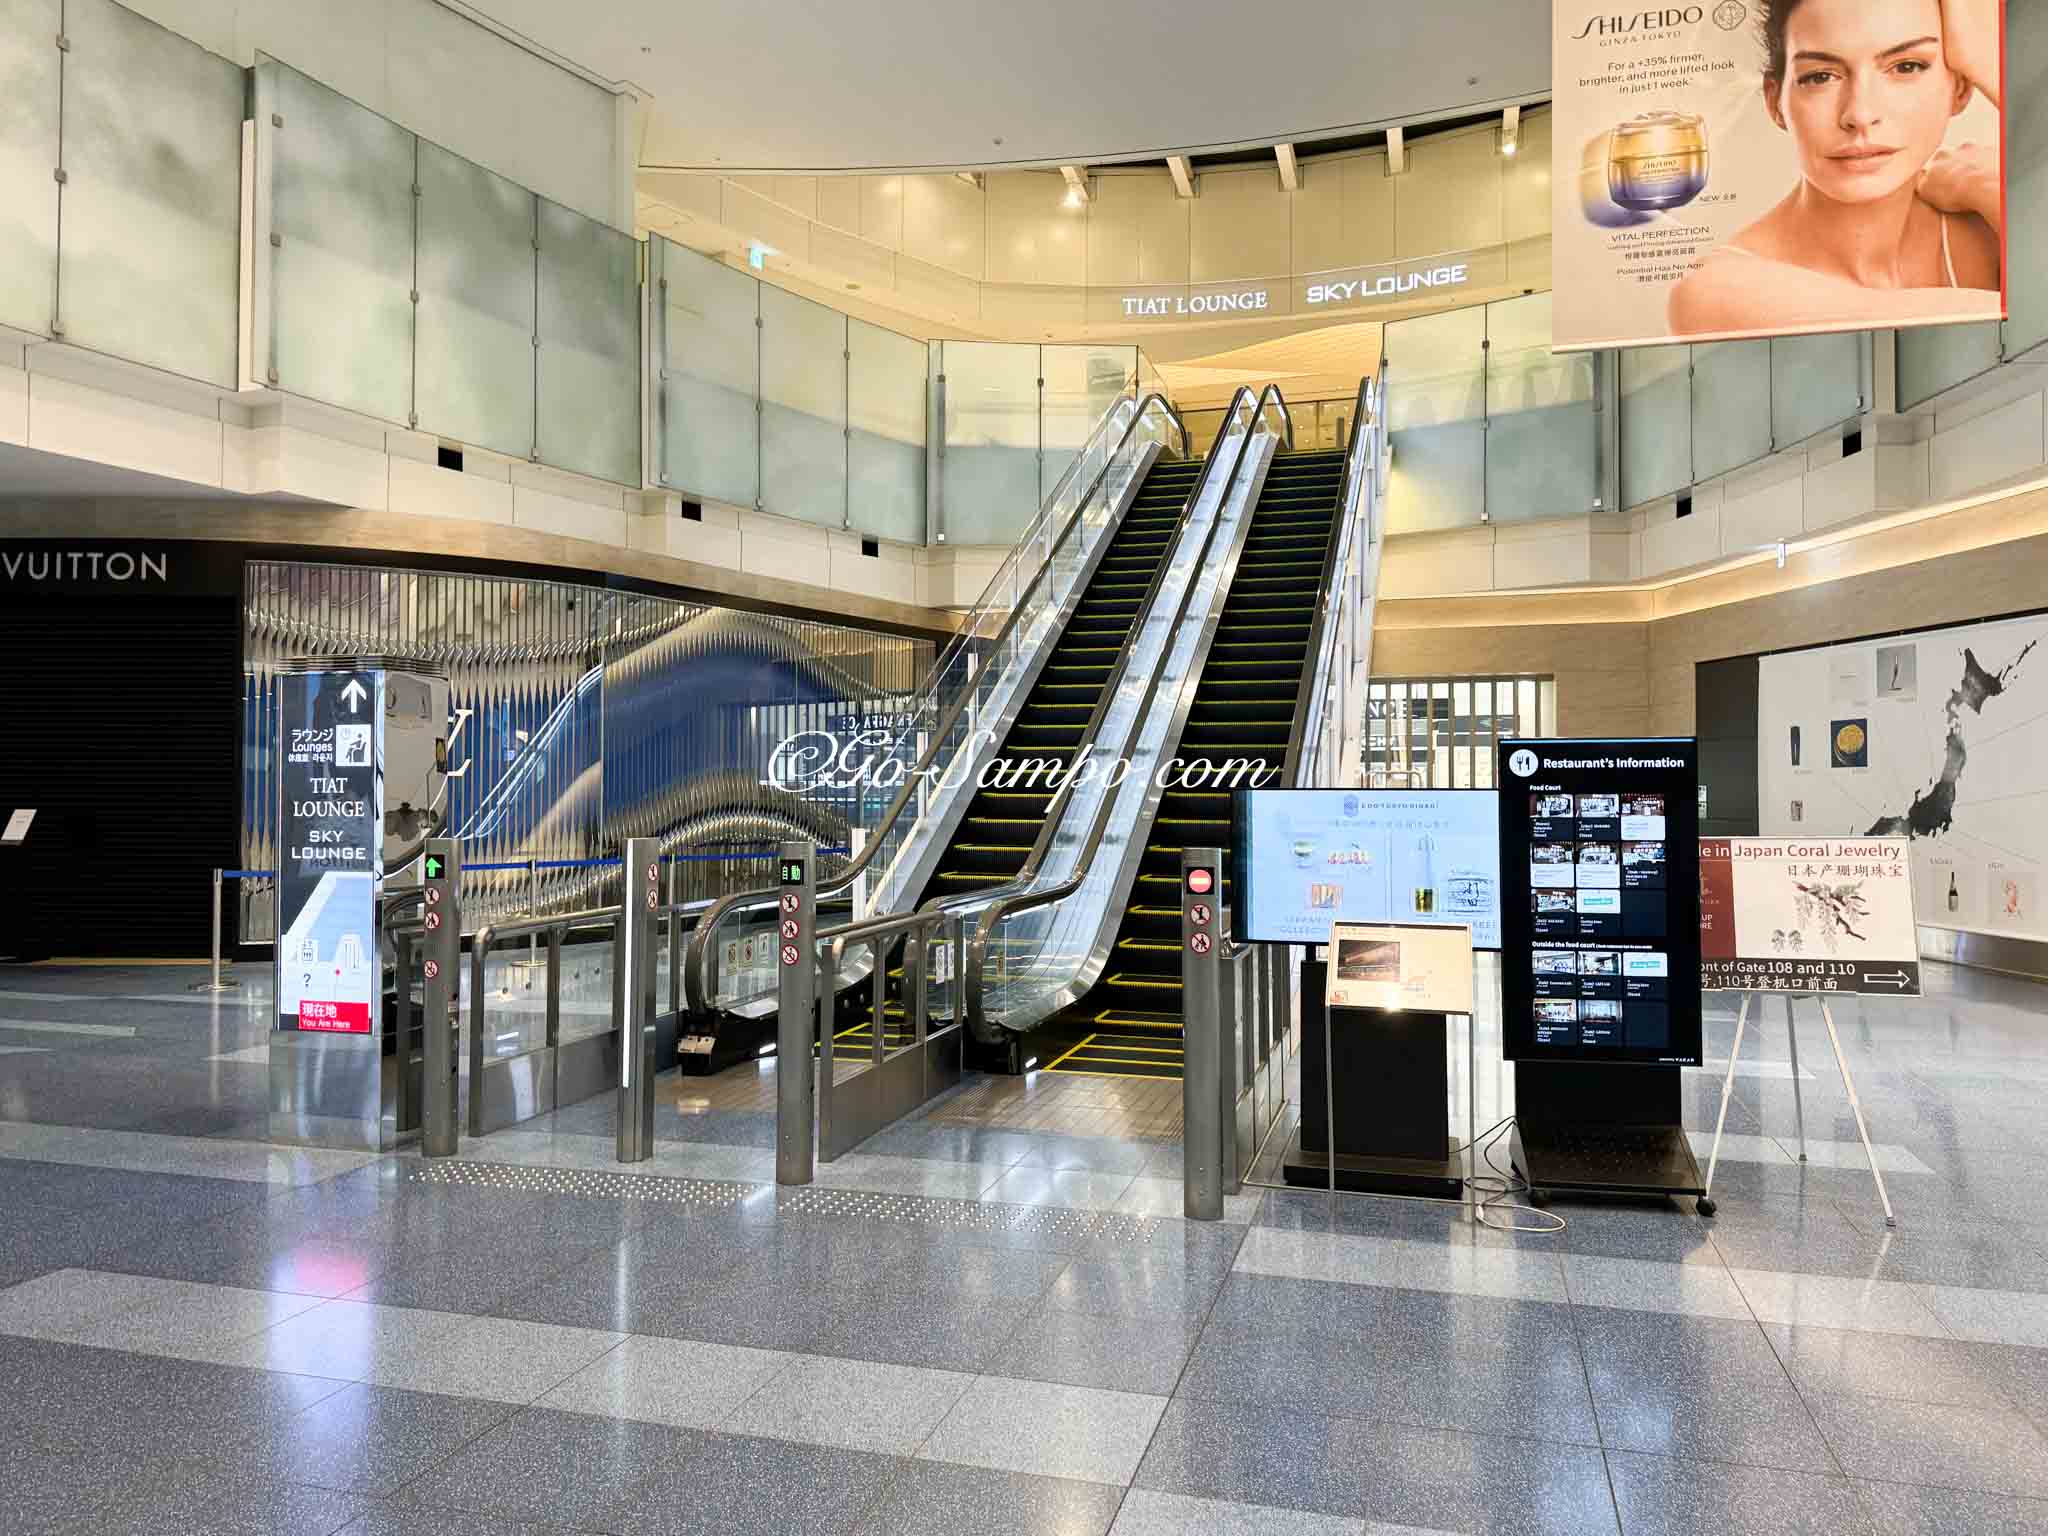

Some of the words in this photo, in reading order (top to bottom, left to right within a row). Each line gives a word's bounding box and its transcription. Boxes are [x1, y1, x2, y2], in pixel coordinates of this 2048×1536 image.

[1570, 6, 1703, 39] SHISEIDO
[1599, 35, 1638, 47] GINZA
[1642, 30, 1681, 42] TOKYO
[1608, 61, 1625, 71] For
[1628, 62, 1635, 70] a
[1638, 56, 1667, 67] +35%
[1627, 71, 1647, 81] and
[1650, 69, 1678, 79] more
[1680, 63, 1709, 75] lifted
[1711, 60, 1735, 71] look
[1619, 86, 1629, 94] in
[1631, 82, 1651, 94] just
[1611, 232, 1640, 242] VITAL
[1642, 226, 1711, 240] PERFECTION
[1673, 263, 1686, 271] No
[1306, 280, 1358, 304] SKY
[1361, 264, 1469, 297] LOUNGE
[1122, 297, 1171, 315] TIAT
[1176, 291, 1268, 314] LOUNGE
[2, 552, 168, 582] VUITTON
[291, 728, 334, 742] ラウンジ
[292, 742, 333, 753] Lounges
[1616, 757, 1685, 769] Information
[309, 777, 348, 794] TIAT
[293, 800, 365, 817] LOUNGE
[309, 830, 344, 843] SKY
[292, 846, 367, 860] LOUNGE
[1716, 843, 1730, 857] in
[1734, 844, 1783, 860] Japan
[1788, 843, 1830, 857] Coral
[1835, 843, 1900, 860] Jewelry
[782, 865, 801, 881] 自動
[1788, 863, 1904, 879] 日本产珊瑚珠宝
[1532, 940, 1555, 948] Outside
[1721, 961, 1734, 972] of
[1736, 961, 1766, 973] Gate
[1767, 962, 1793, 974] 108
[1797, 962, 1825, 975] and
[1829, 963, 1856, 976] 110
[302, 1002, 337, 1018] 現在地
[302, 1019, 316, 1027] You
[319, 1019, 331, 1028] Are
